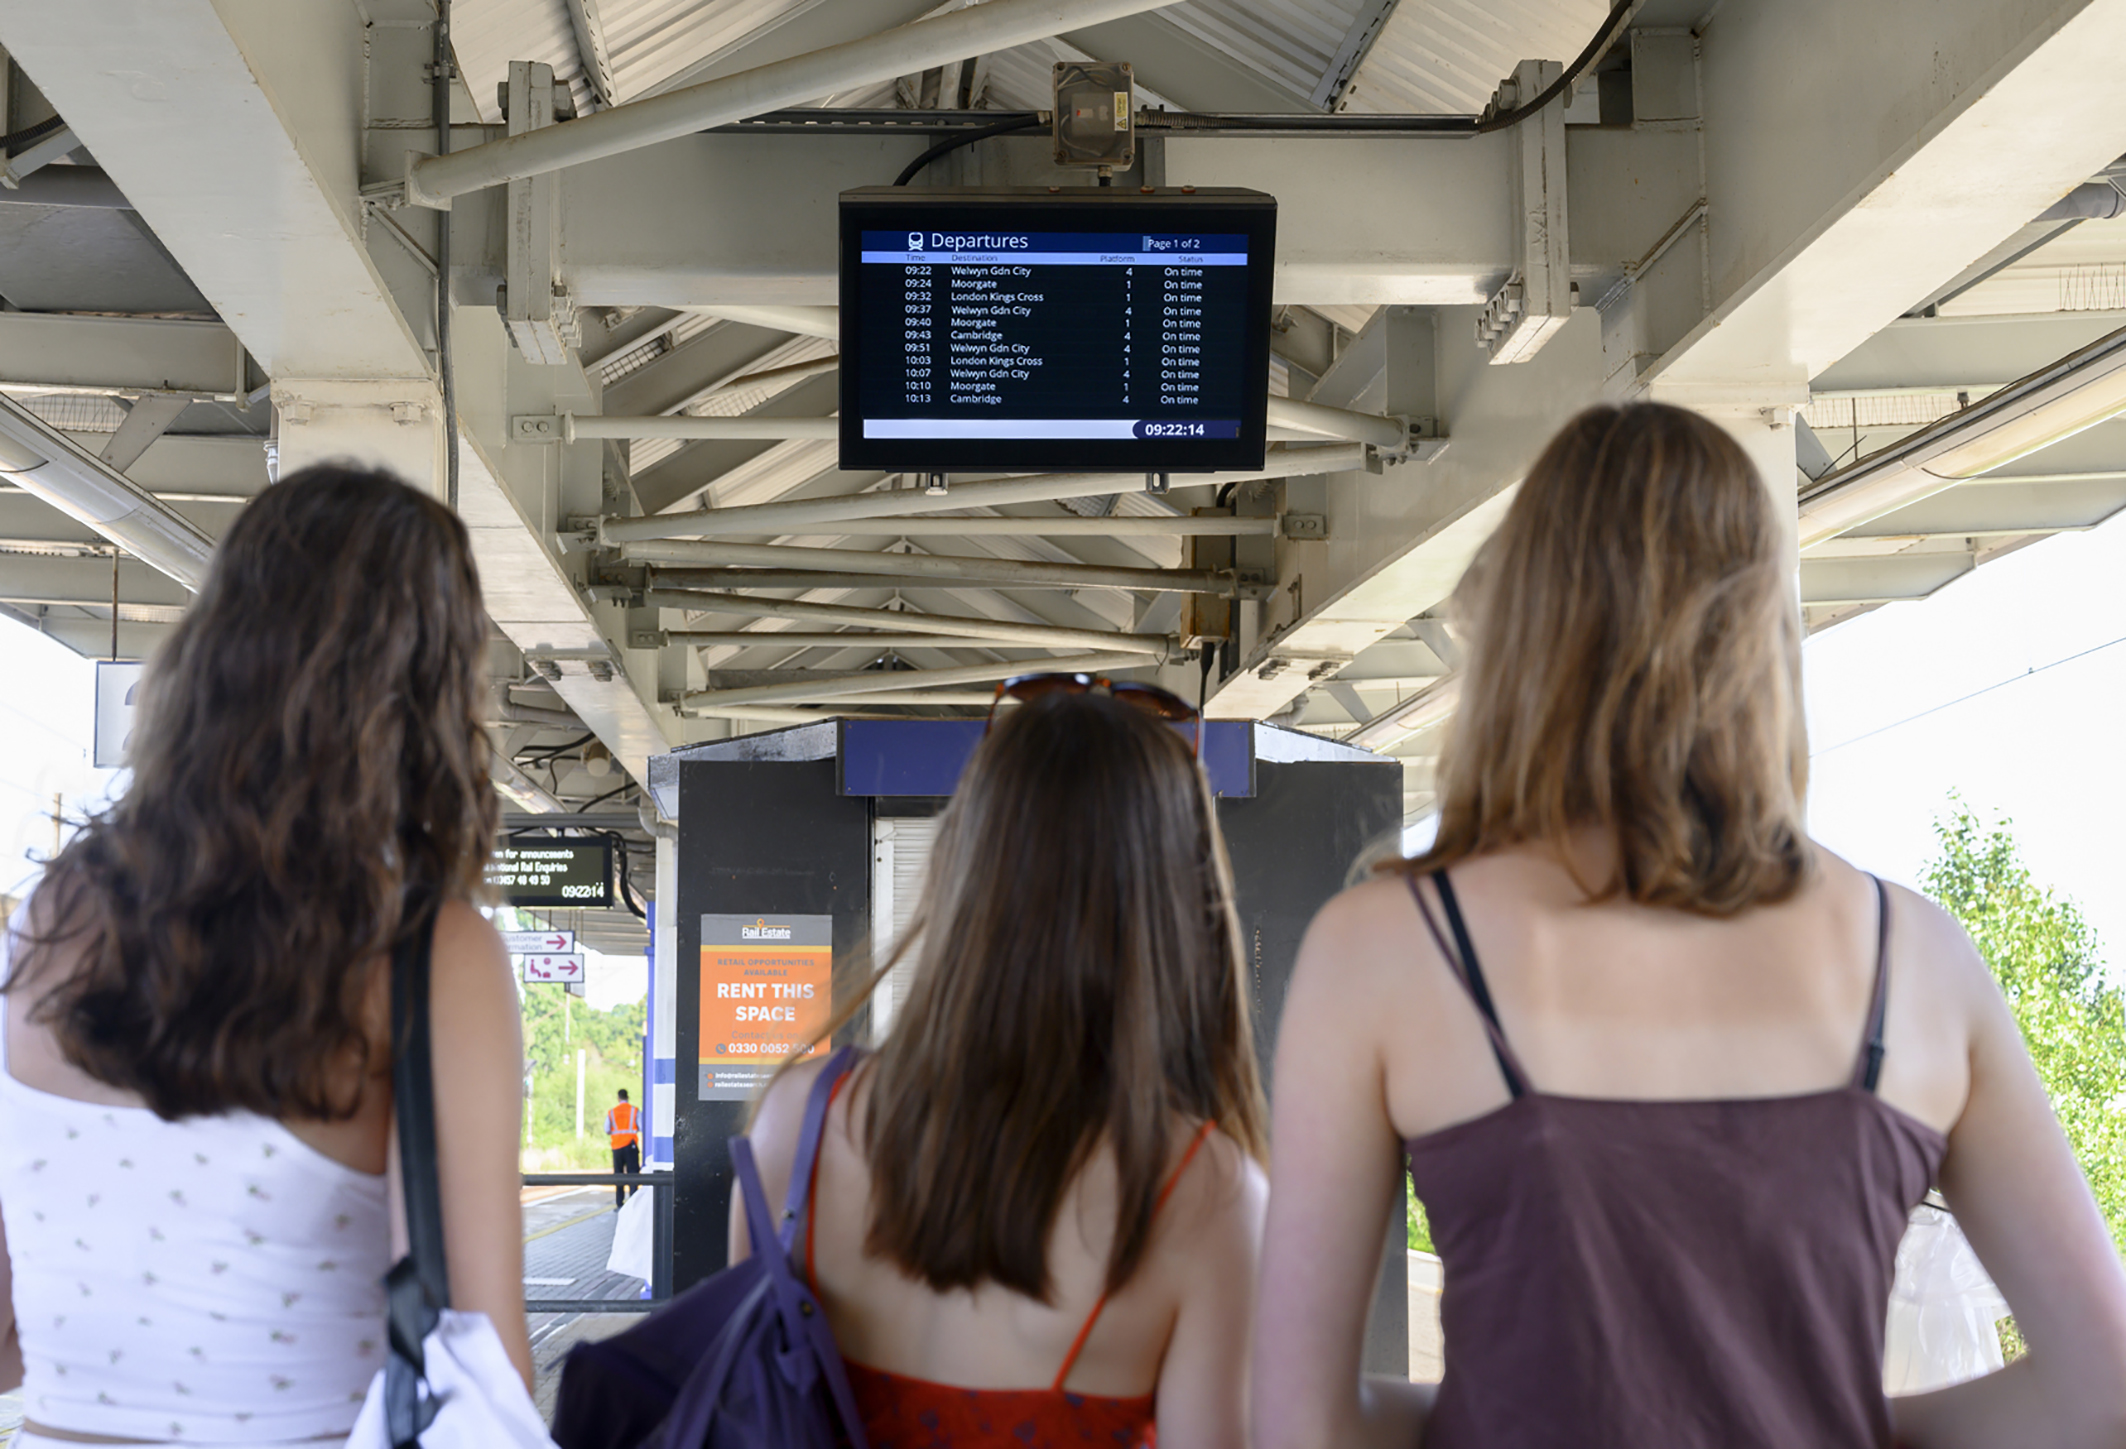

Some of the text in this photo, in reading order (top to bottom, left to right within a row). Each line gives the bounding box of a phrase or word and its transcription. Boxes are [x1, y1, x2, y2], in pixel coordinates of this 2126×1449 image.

[932, 233, 1028, 251] Departures
[1148, 239, 1200, 251] Page 1 of 2
[906, 254, 925, 262] Time
[952, 254, 998, 262] Destination
[1101, 255, 1135, 263] Platform
[1178, 255, 1203, 263] Status
[906, 266, 931, 275] 09:22
[951, 267, 1031, 277] Welwyn Gdn City
[1165, 267, 1202, 276] On time
[905, 279, 931, 287] 09:24
[952, 280, 997, 290] Moorgate
[1164, 281, 1202, 289] On time
[905, 292, 931, 300] 09:32
[990, 293, 1015, 303] Kings
[1017, 293, 1043, 301] Cross
[1164, 293, 1202, 302] On time
[905, 305, 931, 313] 09:37
[952, 306, 1031, 317] Welwyn Gdn City
[1126, 307, 1131, 315] 4
[1163, 307, 1201, 315] On time
[905, 318, 931, 326] 09:40
[951, 318, 996, 329] Moorgate
[1125, 319, 1129, 327] 1
[1163, 319, 1201, 328] On time
[905, 331, 931, 339] 09:43
[951, 331, 1002, 342] Cambridge
[1125, 332, 1130, 340] 4
[1163, 332, 1200, 341] On time
[905, 343, 929, 352] 09:51
[951, 344, 1030, 354] Welwyn Gdn City
[1162, 345, 1200, 353] On time
[906, 356, 931, 364] 10:03
[951, 357, 1042, 367] London Kings Cross
[1162, 358, 1199, 366] On time
[906, 368, 931, 377] 10:07
[950, 369, 1029, 380] Welwyn Gdn City
[1161, 370, 1199, 378] On time
[906, 382, 931, 390] 10:10
[951, 382, 995, 392] Moorgate
[1161, 383, 1199, 391] On time
[906, 394, 930, 402] 10:13
[950, 395, 1001, 404] Cambridge
[1161, 396, 1198, 404] On time
[1145, 424, 1204, 435] 09:22:14
[505, 849, 519, 859] for
[520, 849, 574, 859] announcements
[490, 862, 519, 872] ational
[520, 862, 534, 872] Rail
[535, 862, 568, 874] Enquiries
[742, 927, 791, 938] Rail Estate
[504, 934, 543, 942] ustomer
[717, 983, 814, 999] RENT THIS
[735, 1006, 795, 1021] SPACE
[731, 1030, 770, 1039] Contact
[728, 1043, 758, 1054] 0330
[760, 1043, 790, 1054] 0052
